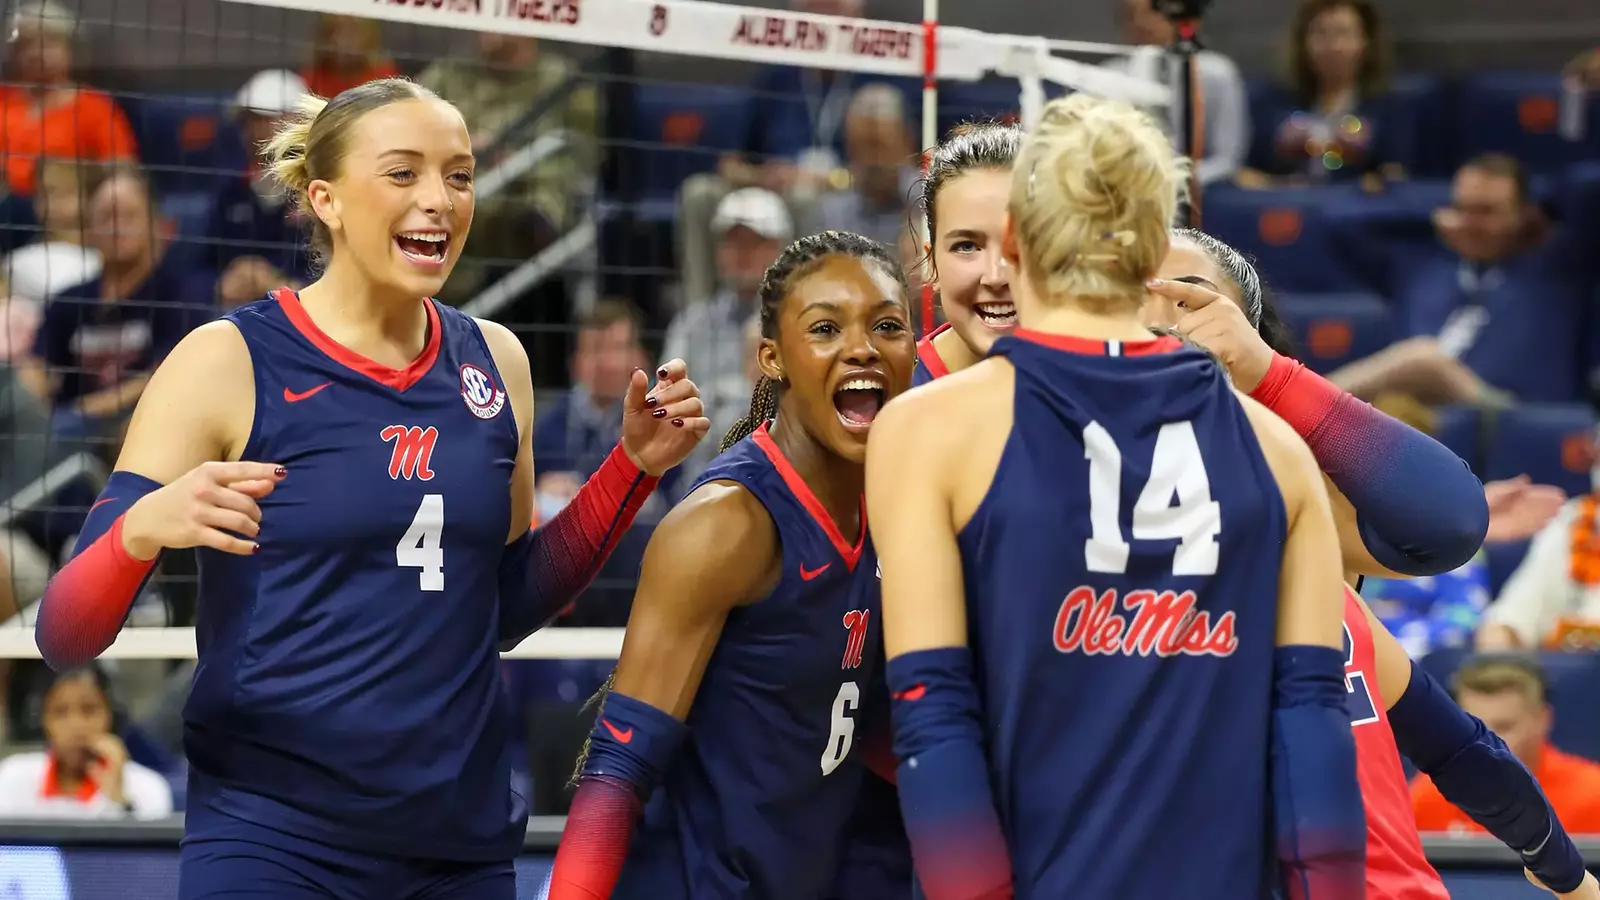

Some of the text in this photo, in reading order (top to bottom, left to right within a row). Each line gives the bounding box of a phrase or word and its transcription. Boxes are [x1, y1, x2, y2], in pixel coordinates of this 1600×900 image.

[734, 15, 912, 58] AUBURN TIGERS
[462, 367, 492, 405] SEC
[467, 399, 502, 418] ADUATE
[380, 425, 438, 481] M
[1083, 420, 1221, 576] 14
[396, 494, 445, 591] 4
[1053, 585, 1238, 657] Ole Miss
[820, 681, 859, 776] 6
